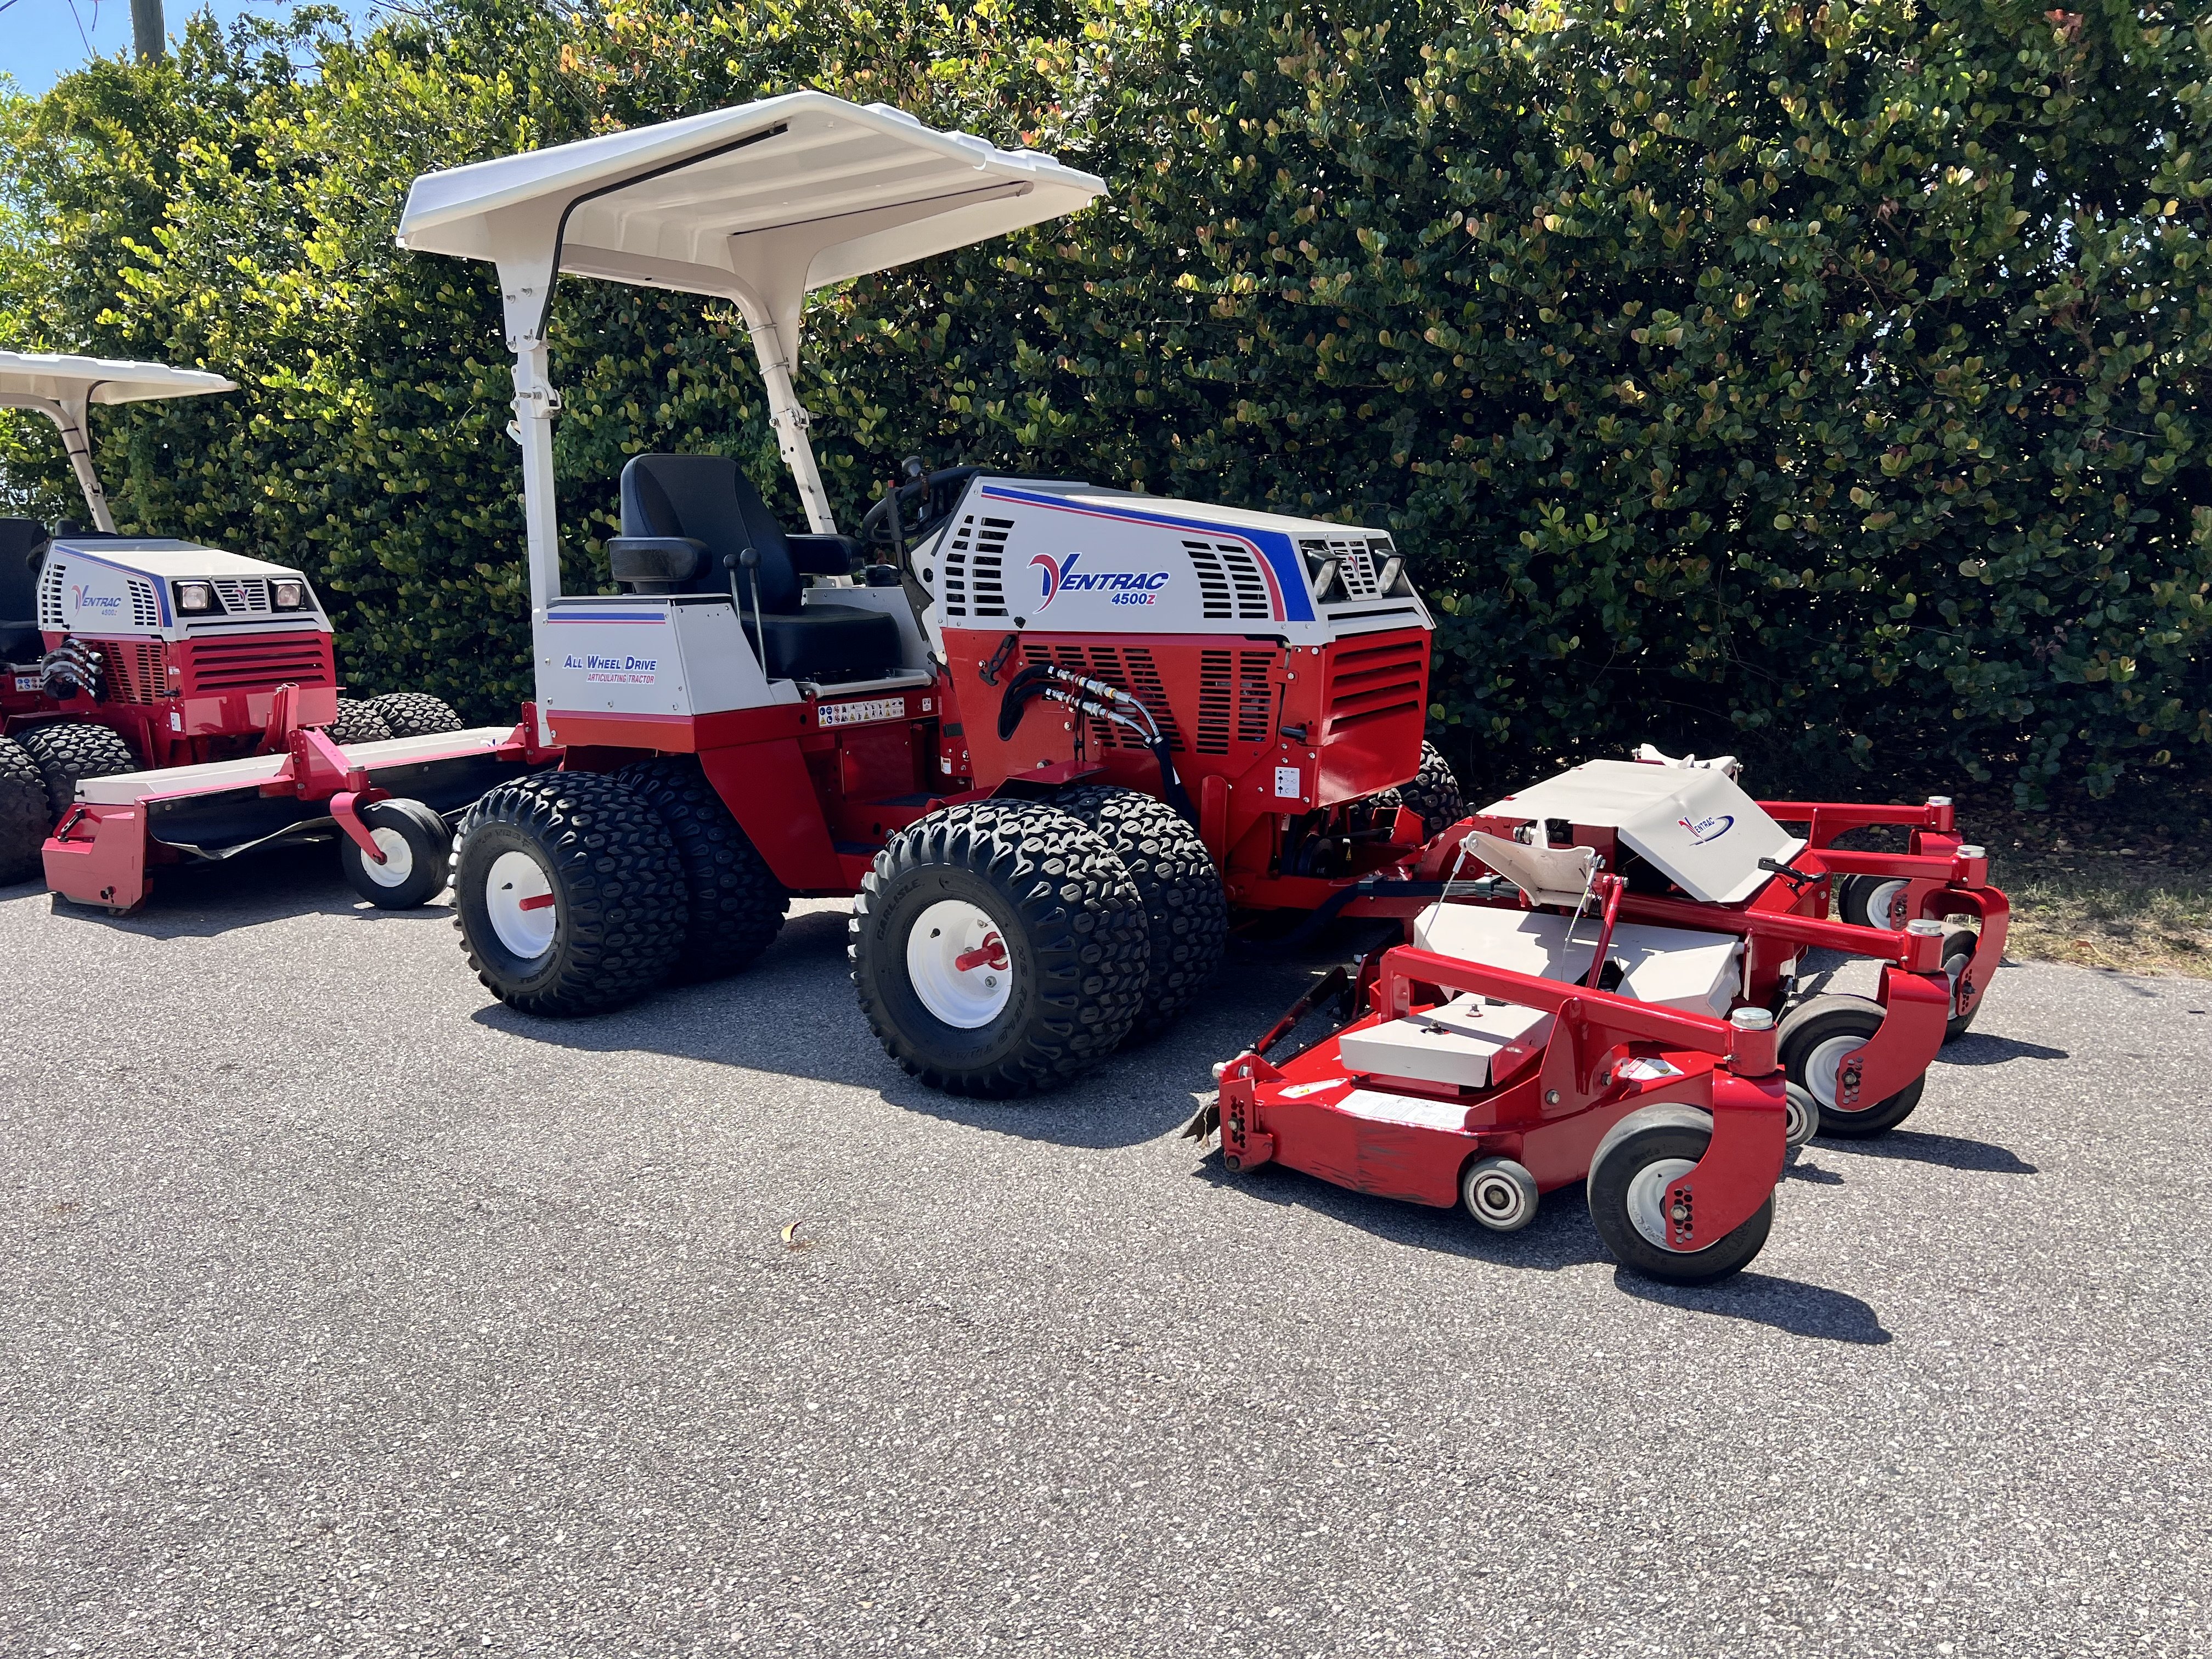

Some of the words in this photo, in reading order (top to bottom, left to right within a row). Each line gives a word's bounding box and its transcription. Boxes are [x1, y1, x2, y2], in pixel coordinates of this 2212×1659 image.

[71, 585, 121, 618] VENTRAC
[1027, 552, 1169, 614] VENTRAC
[588, 673, 627, 682] ARTICULATING
[628, 675, 655, 684] TRACTOR
[877, 878, 921, 941] CARLISLE
